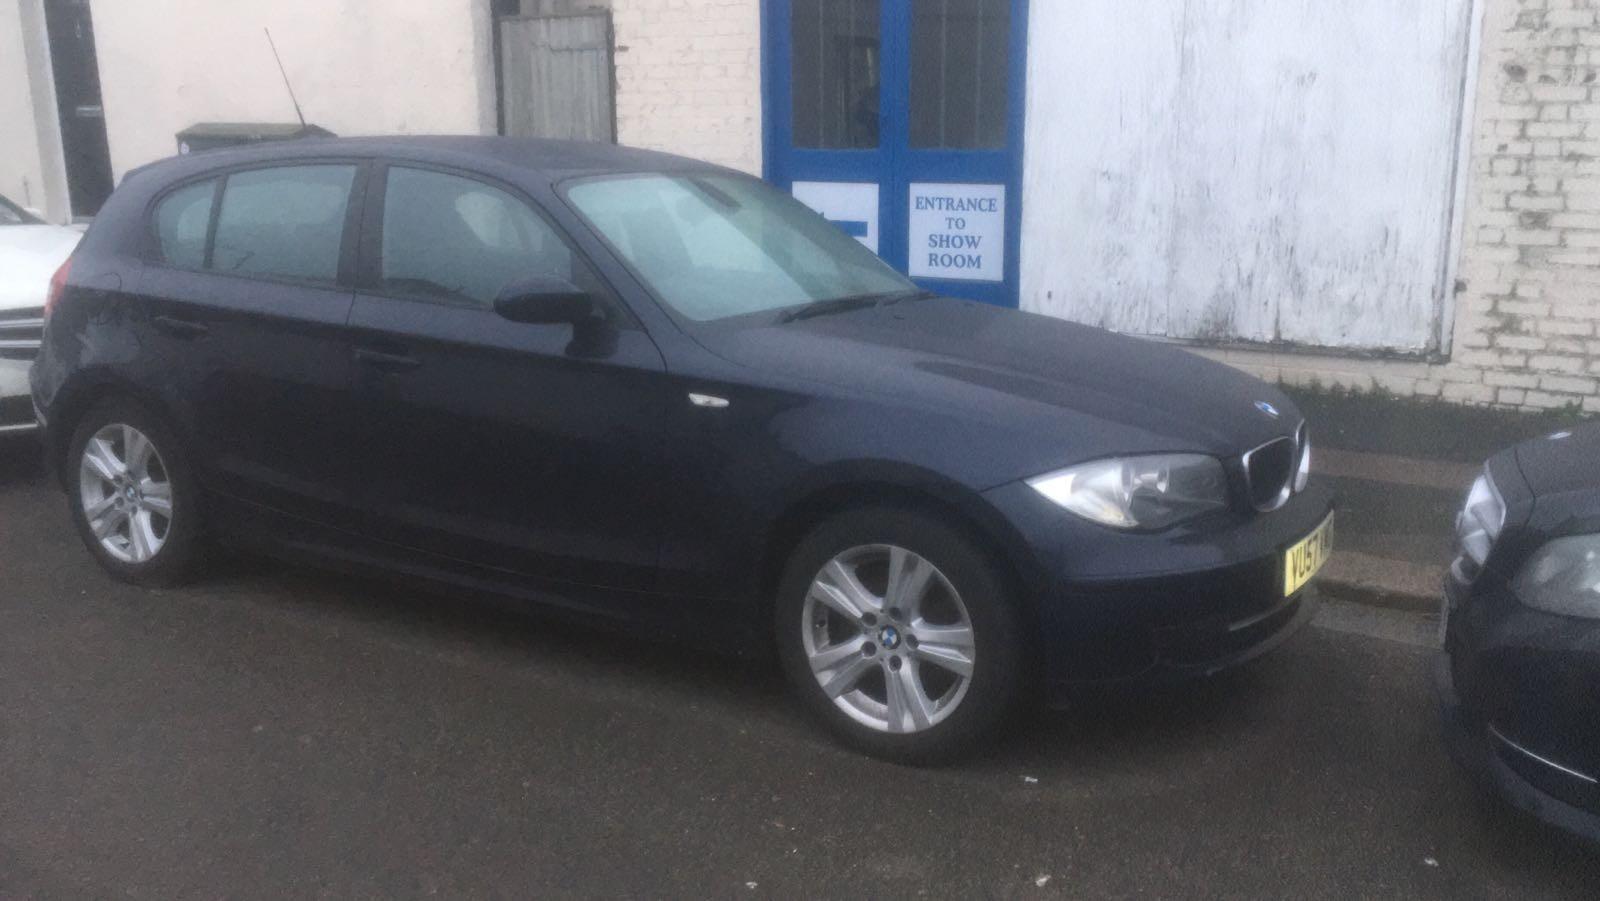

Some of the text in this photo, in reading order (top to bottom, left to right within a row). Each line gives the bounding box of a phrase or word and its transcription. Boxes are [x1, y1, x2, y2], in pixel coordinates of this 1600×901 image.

[915, 196, 998, 212] ENTRANCE
[945, 217, 966, 230] TO
[928, 233, 982, 250] SHOW
[928, 253, 982, 269] ROOM
